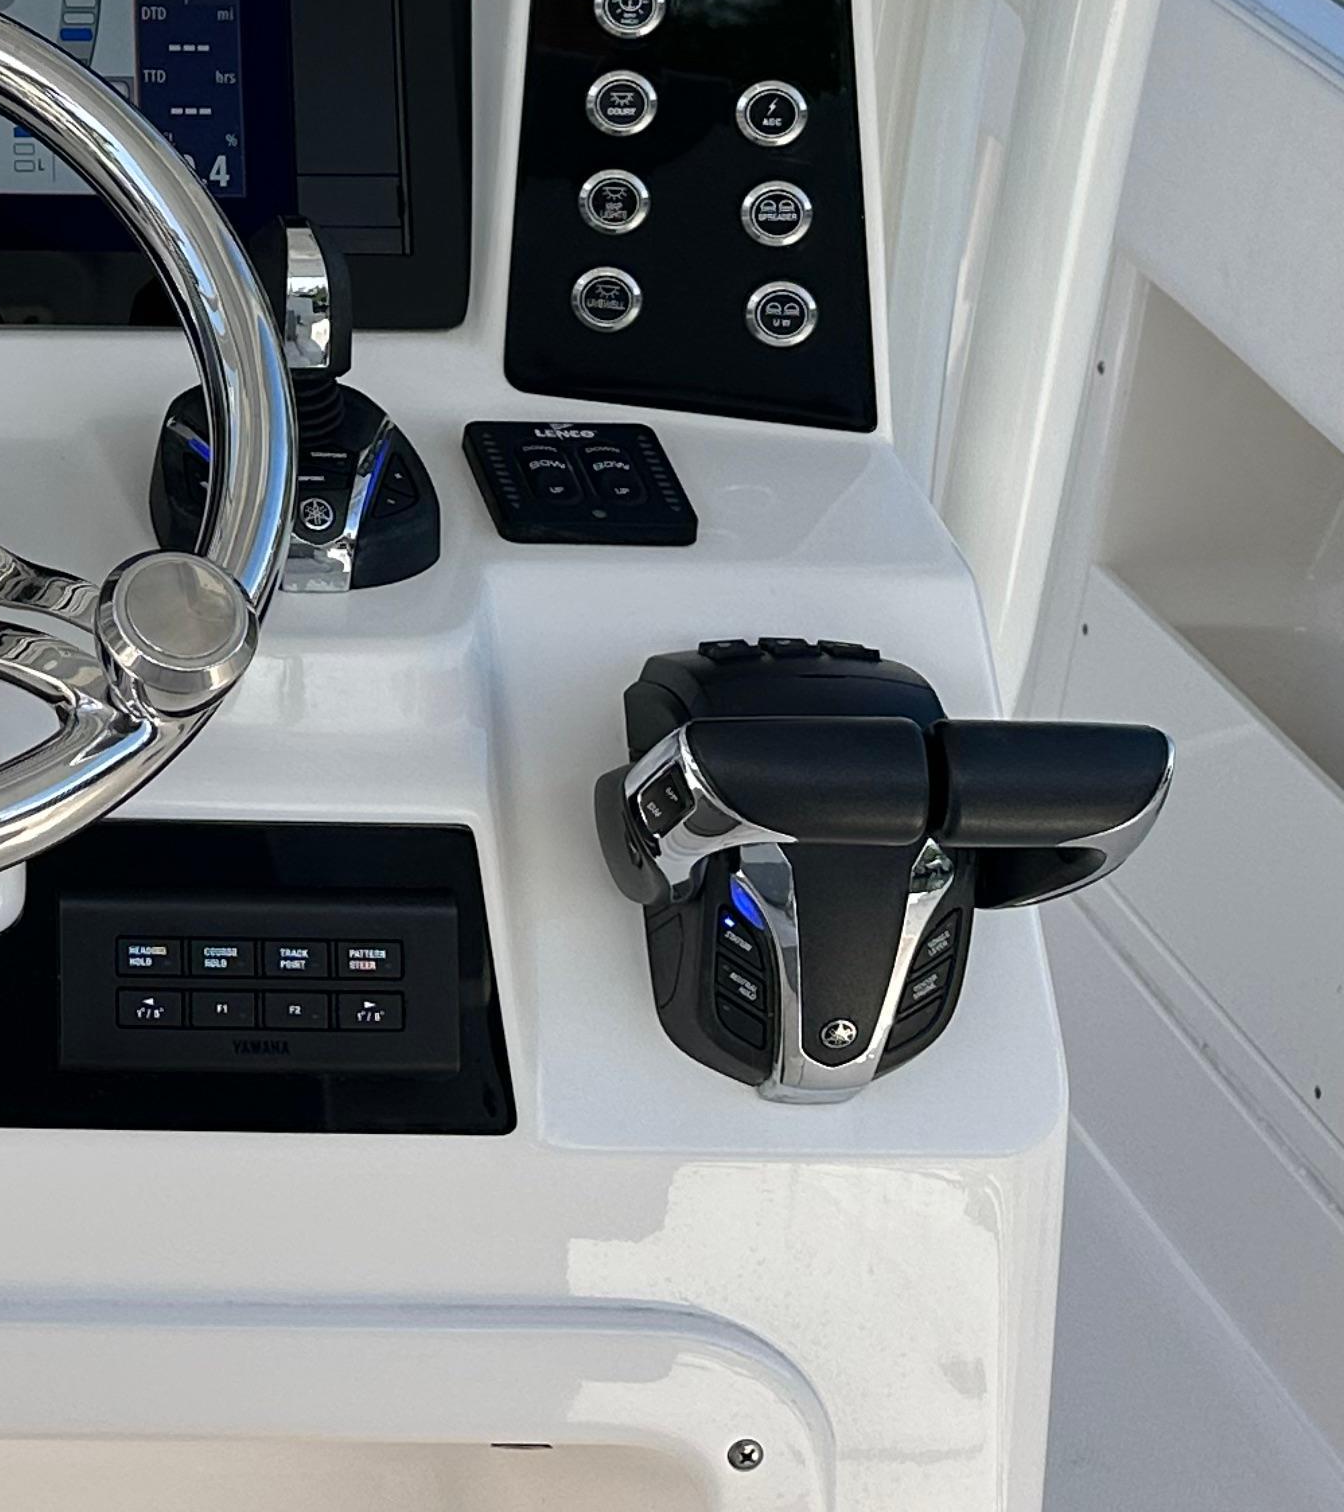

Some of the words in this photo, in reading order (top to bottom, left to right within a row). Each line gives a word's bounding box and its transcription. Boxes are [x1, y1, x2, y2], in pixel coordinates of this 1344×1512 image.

[142, 7, 167, 20] DTD
[217, 7, 234, 20] mi
[143, 70, 166, 84] TTD
[216, 70, 236, 84] hrs
[226, 134, 238, 147] %
[534, 428, 595, 439] LENCO
[216, 1004, 228, 1015] F1
[289, 1005, 301, 1016] F2
[232, 1040, 290, 1056] YAMAHA
